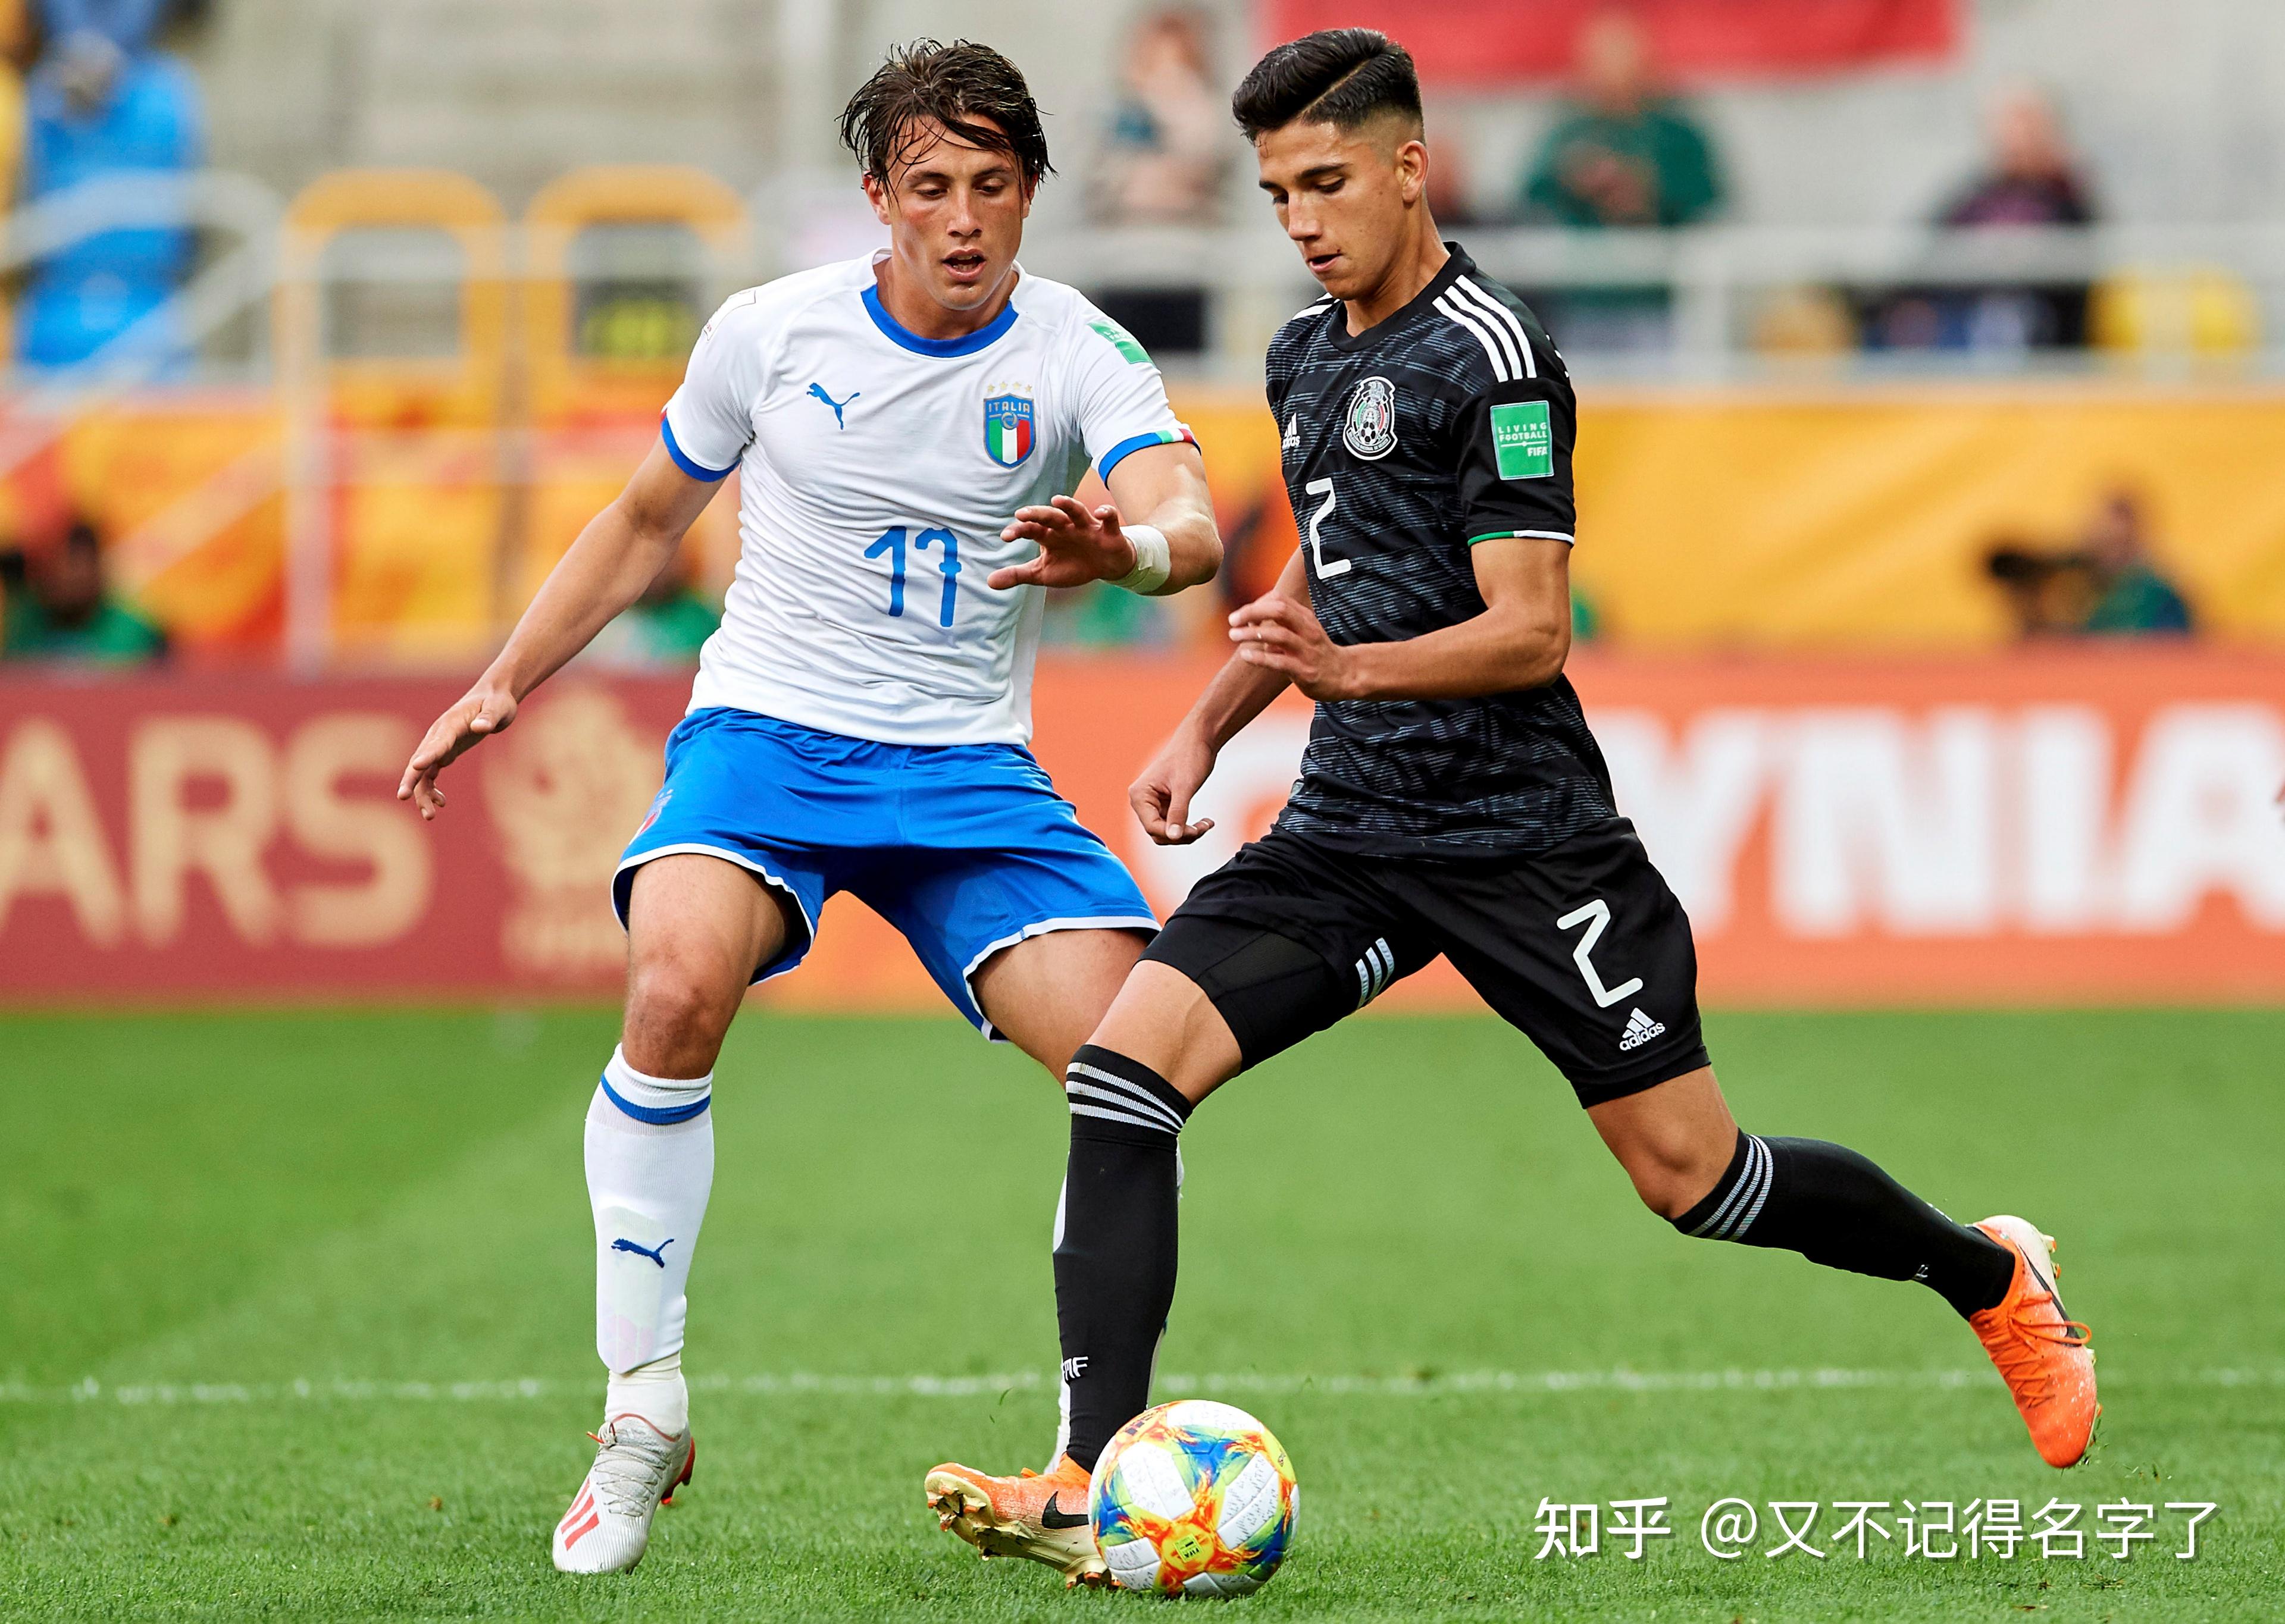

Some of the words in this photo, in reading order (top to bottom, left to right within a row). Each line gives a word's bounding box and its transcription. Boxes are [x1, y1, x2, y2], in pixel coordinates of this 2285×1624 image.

[988, 401, 1030, 413] ITALIA
[1498, 422, 1547, 434] LIVING
[1499, 431, 1547, 441] FOOTBALL
[1527, 447, 1548, 456] FIFA
[1306, 477, 1351, 579] 2
[864, 525, 962, 628] 17
[1556, 899, 1644, 1008] 2
[1619, 1022, 1666, 1051] adidas
